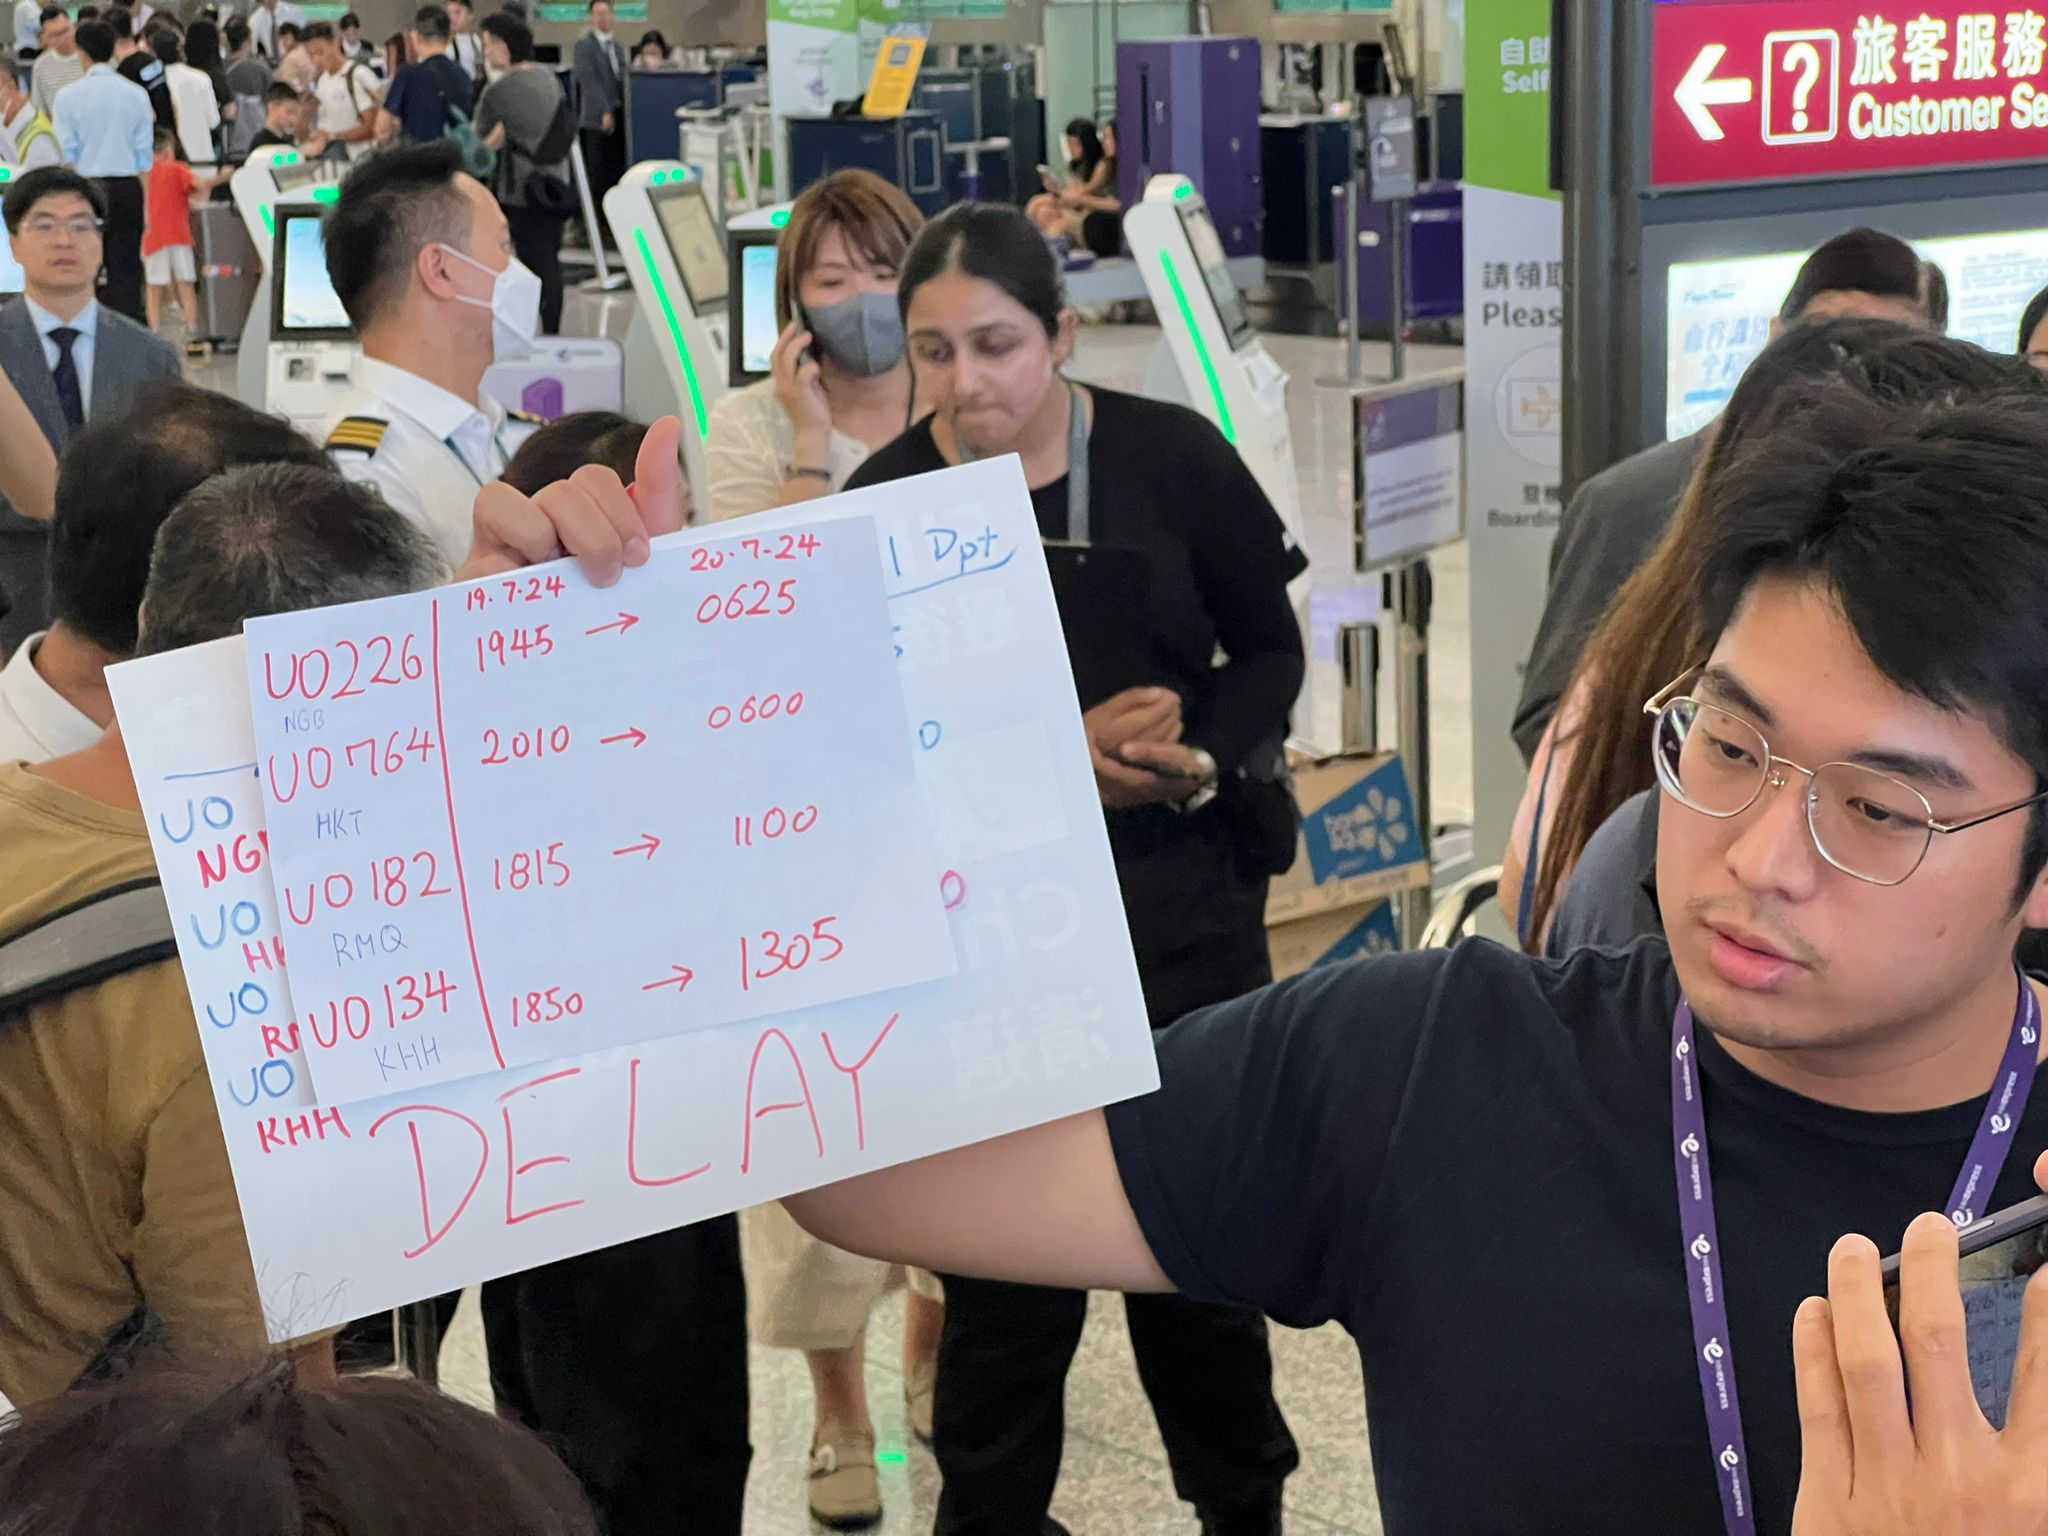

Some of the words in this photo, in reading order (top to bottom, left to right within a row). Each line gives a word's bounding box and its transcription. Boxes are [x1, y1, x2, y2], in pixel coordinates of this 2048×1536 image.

[1850, 10, 2046, 86] 旅客服務
[1848, 93, 2005, 140] Customer
[2010, 81, 2048, 129] Se
[1482, 301, 1562, 328] Pleas
[924, 523, 999, 575] Dpt
[478, 624, 554, 672] 1945
[697, 579, 797, 624] 0625
[284, 708, 325, 733] NGB
[481, 725, 570, 765] 2010
[708, 691, 804, 729] 0600
[316, 808, 363, 840] HKT
[495, 843, 571, 890] 1815
[735, 806, 819, 847] 1100
[332, 924, 409, 968] RMQ
[511, 986, 584, 1027] 1850
[740, 916, 844, 991] 1305
[374, 1035, 442, 1082] KHH
[256, 1106, 352, 1155] KHH
[367, 1012, 900, 1260] DELAY
[1690, 1153, 1702, 1201] express
[1702, 1255, 1714, 1303] express
[1715, 1359, 1729, 1410] express
[1731, 1466, 1744, 1517] express
